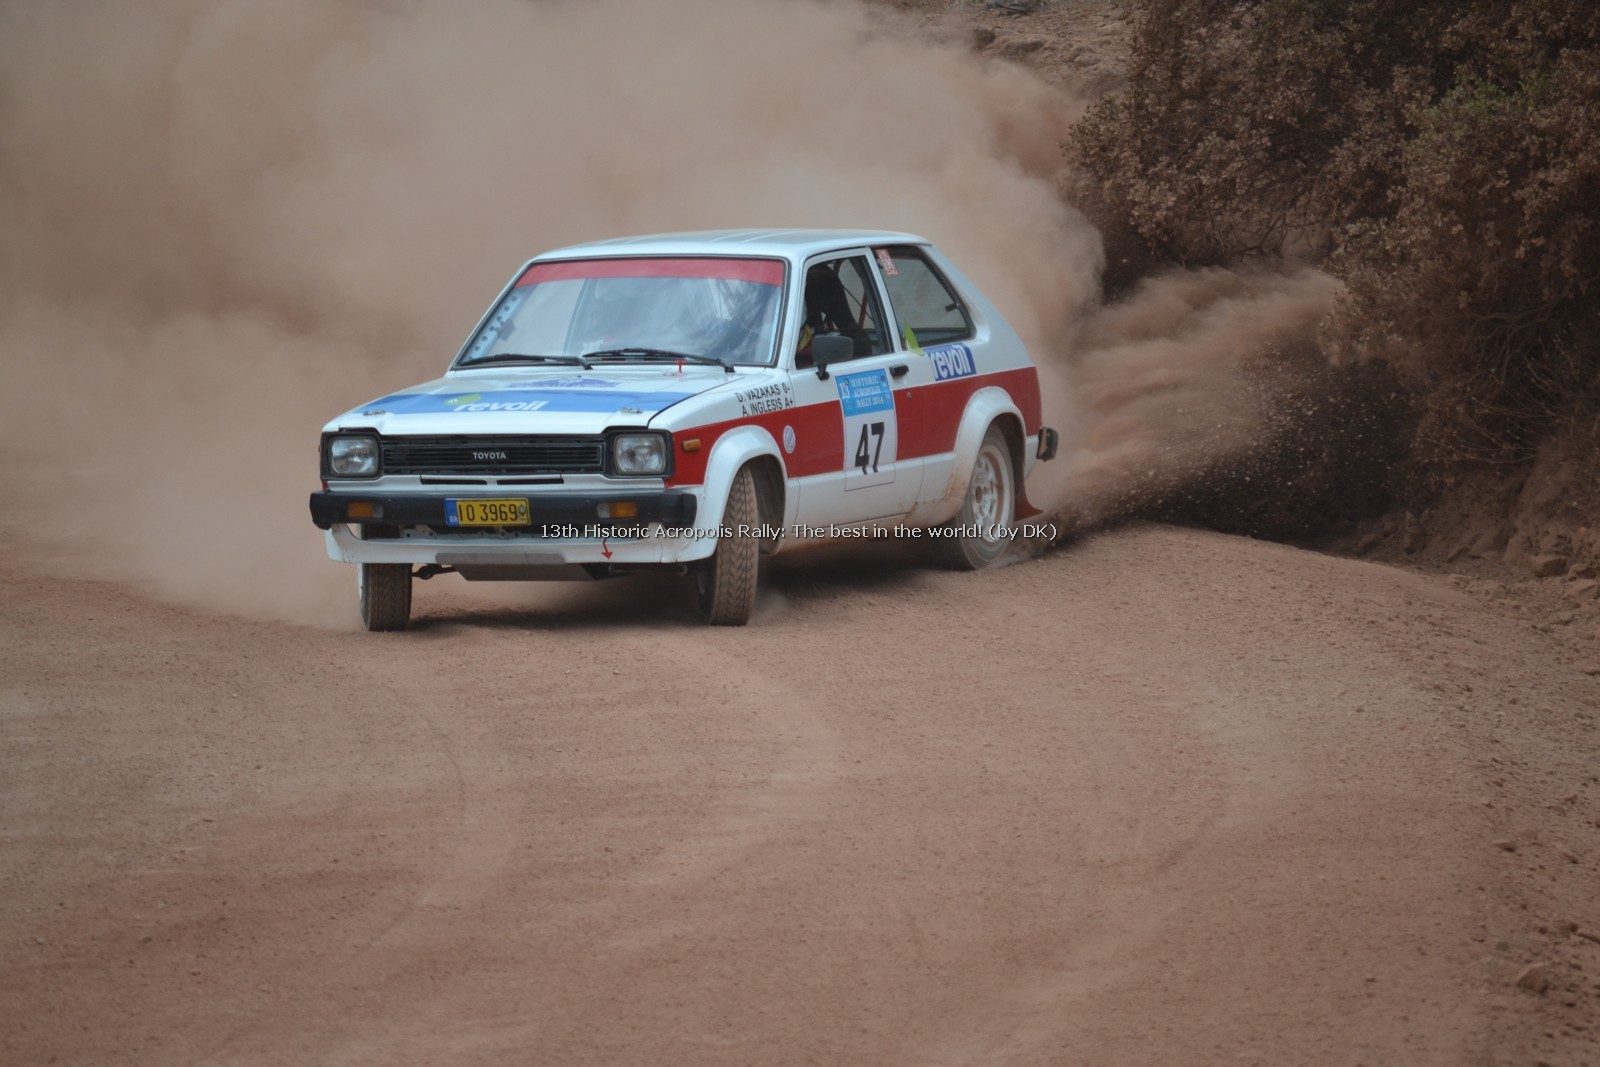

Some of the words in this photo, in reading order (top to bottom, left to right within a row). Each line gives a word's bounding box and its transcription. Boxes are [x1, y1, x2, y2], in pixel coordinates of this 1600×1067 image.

[929, 345, 972, 379] revoil
[745, 384, 781, 401] VAZAKAS
[453, 400, 549, 412] revoil
[750, 397, 783, 415] INGLESIS
[472, 451, 507, 460] TOYOTA
[855, 422, 885, 475] 47
[479, 503, 518, 521] 3969
